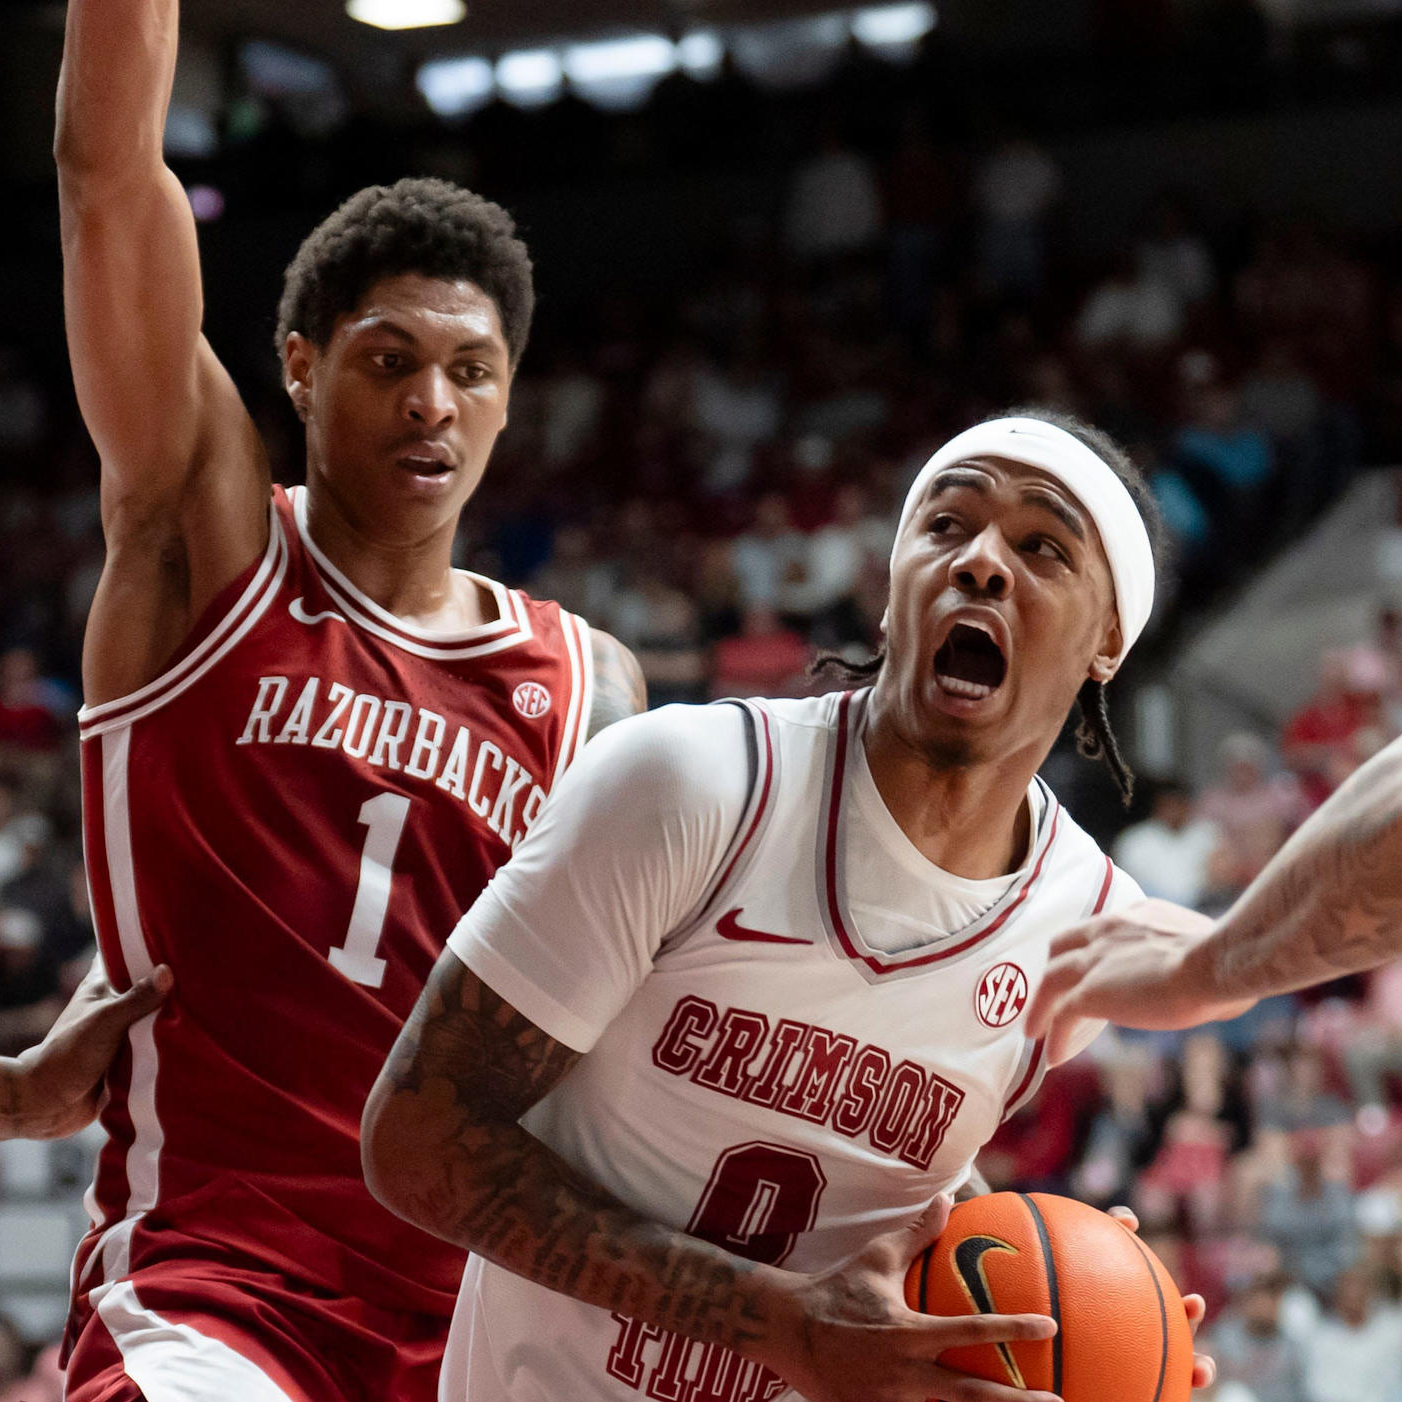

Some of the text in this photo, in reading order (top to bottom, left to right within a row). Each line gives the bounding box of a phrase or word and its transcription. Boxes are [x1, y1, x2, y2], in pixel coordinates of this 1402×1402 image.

[235, 676, 548, 848] RAZORBACKS
[513, 683, 550, 717] SEC
[327, 791, 411, 989] 1
[977, 962, 1028, 1028] SEC
[651, 993, 967, 1172] CRIMSON
